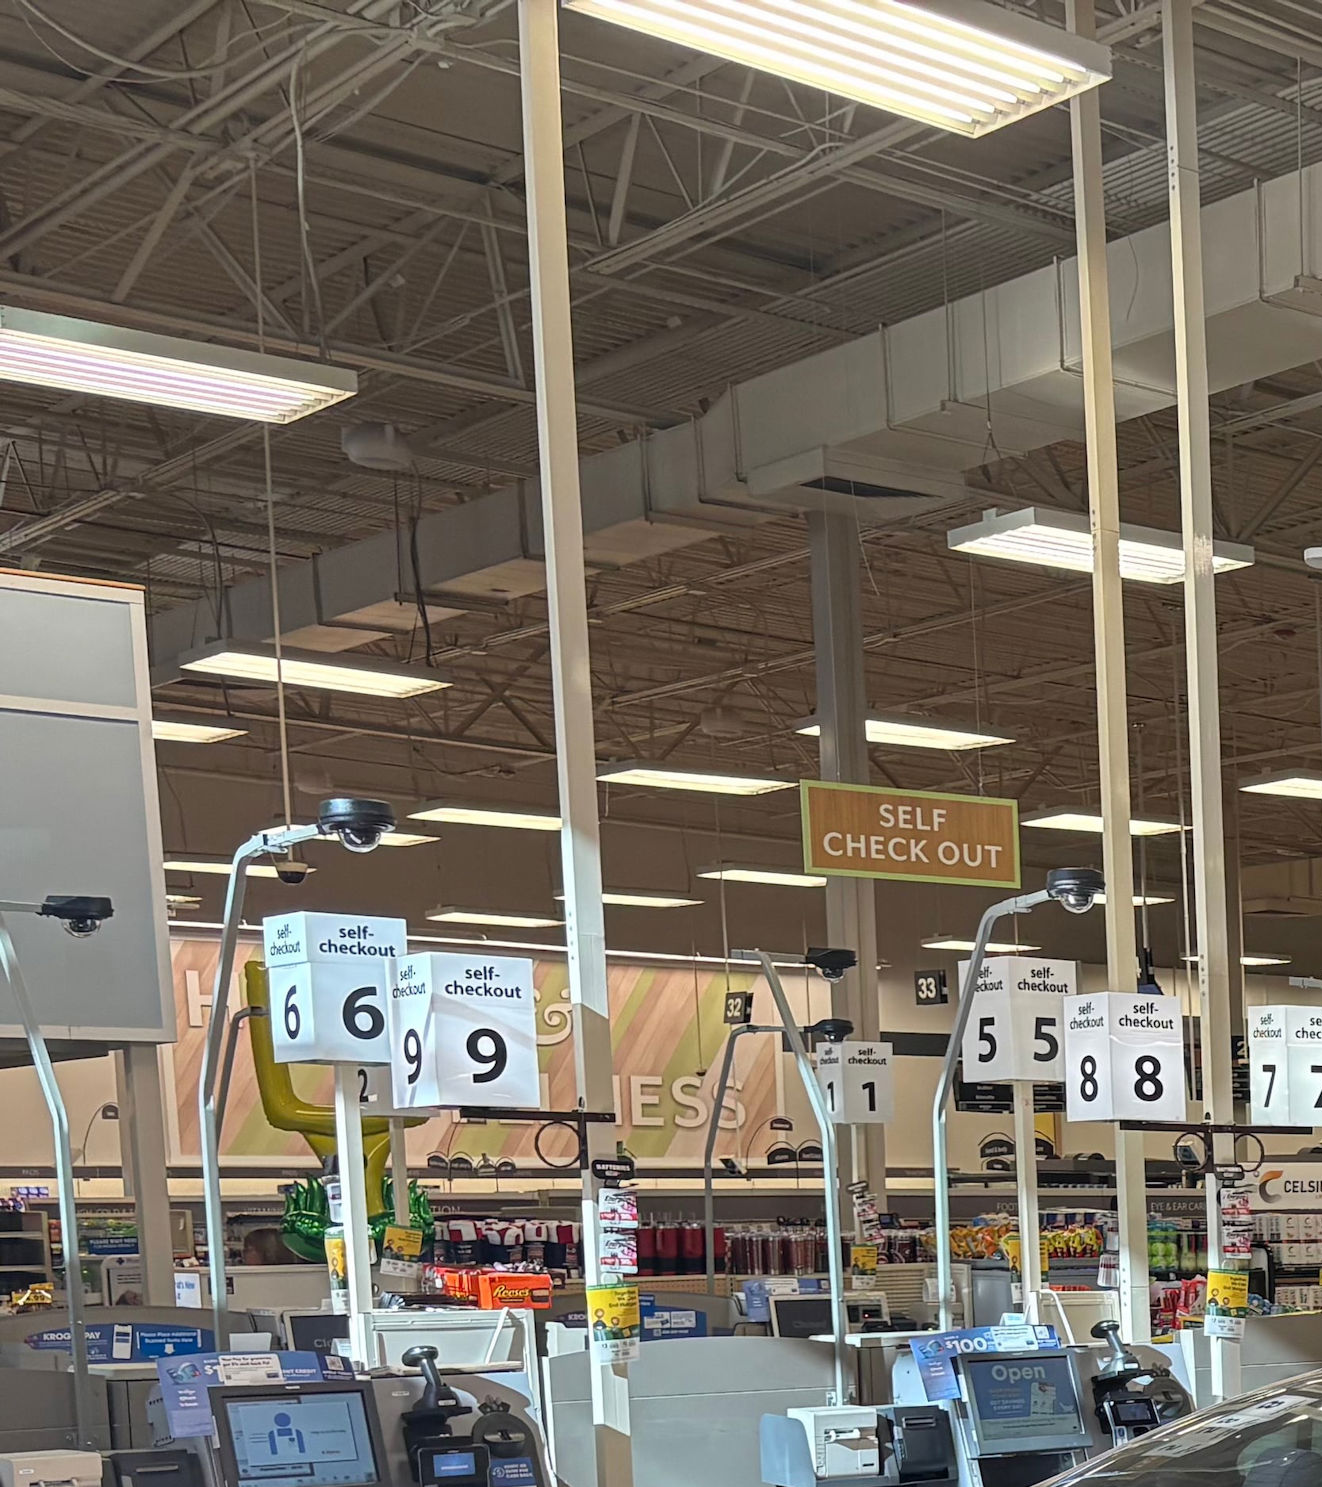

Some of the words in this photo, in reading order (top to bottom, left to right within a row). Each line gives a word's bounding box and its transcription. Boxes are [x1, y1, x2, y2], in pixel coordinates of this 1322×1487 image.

[878, 803, 948, 832] SELF
[822, 831, 929, 863] CHECK
[937, 842, 1003, 869] OUT
[339, 926, 375, 940] self-
[270, 941, 301, 956] checkout
[319, 941, 396, 957] checkout
[465, 966, 501, 981] self-
[1030, 967, 1054, 979] self-
[445, 981, 522, 999] checkout
[918, 978, 937, 999] 33
[1017, 979, 1068, 993] checkout
[284, 985, 300, 1039] 6
[342, 986, 385, 1040] 6
[727, 998, 742, 1017] 32
[1078, 1001, 1095, 1016] self-
[1133, 1002, 1159, 1014] self-
[1070, 1016, 1104, 1030] checkout
[1118, 1014, 1174, 1030] checkout
[978, 1017, 997, 1063] 5
[1033, 1017, 1058, 1062] 5
[1253, 1026, 1282, 1039] checkout
[404, 1028, 422, 1085] 9
[466, 1028, 508, 1084] 9
[848, 1056, 887, 1066] checkout
[858, 1048, 877, 1056] self-
[1080, 1055, 1098, 1102] 8
[1134, 1055, 1163, 1102] 8
[1262, 1064, 1276, 1108] 7
[827, 1081, 835, 1112] 1
[862, 1081, 876, 1112] 1
[43, 1331, 71, 1340] KROG
[992, 1364, 1046, 1383] Open
